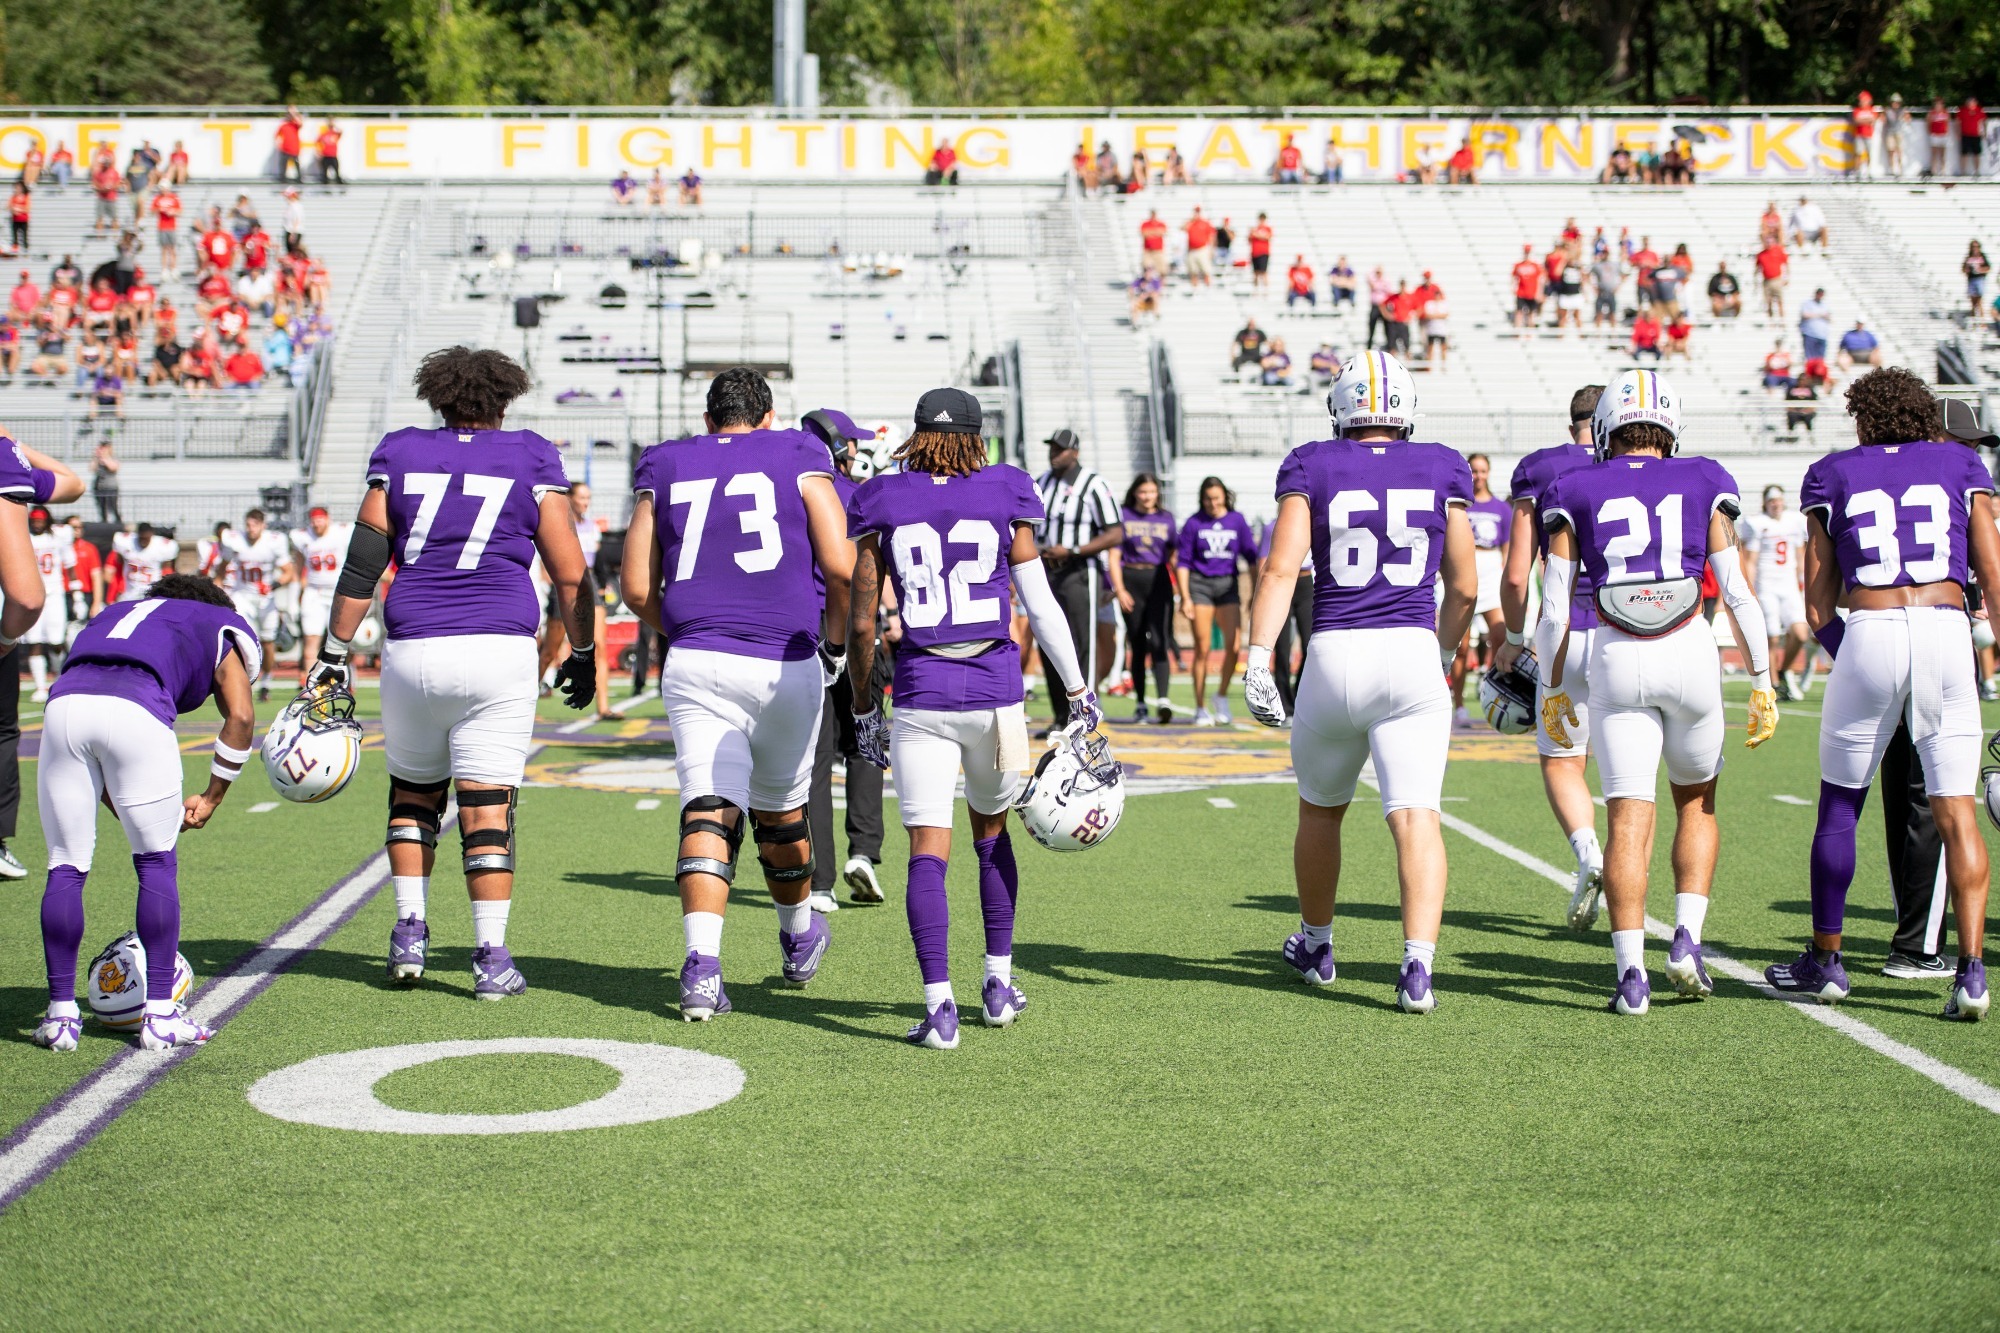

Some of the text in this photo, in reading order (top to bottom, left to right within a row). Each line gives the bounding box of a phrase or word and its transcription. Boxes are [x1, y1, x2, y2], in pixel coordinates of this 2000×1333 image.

[0, 123, 121, 169] OF
[503, 124, 1009, 169] FIGHTING
[1350, 416, 1405, 426] POUND THE ROCK
[1619, 410, 1674, 428] POUND THE ROCK
[402, 472, 516, 570] 77
[670, 471, 784, 581] 73
[1328, 489, 1436, 587] 65
[1597, 493, 1684, 585] 21
[1845, 483, 1951, 587] 33
[891, 518, 1001, 629] 82
[1776, 541, 1788, 565] 9
[106, 599, 168, 640] 1
[282, 747, 318, 785] 77
[1070, 808, 1109, 845] 82
